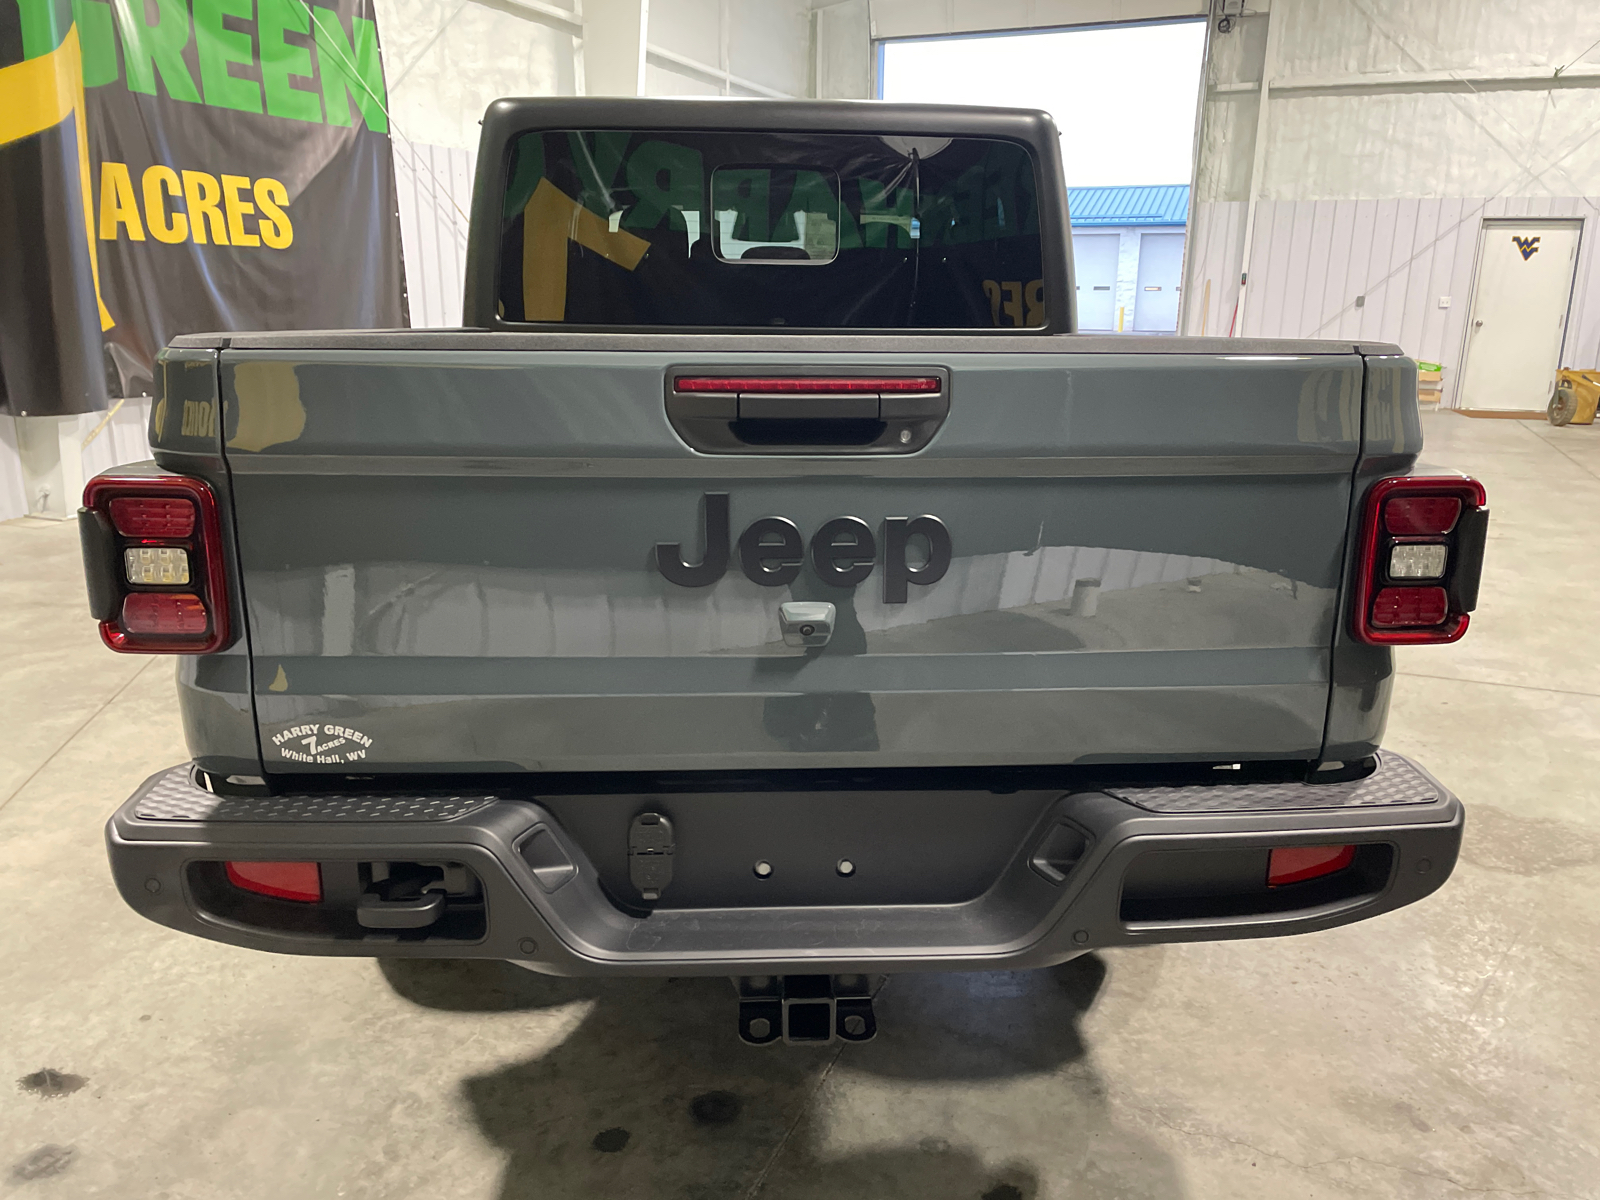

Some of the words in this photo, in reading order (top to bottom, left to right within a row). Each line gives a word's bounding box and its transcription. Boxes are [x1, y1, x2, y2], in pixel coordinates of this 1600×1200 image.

[99, 162, 294, 250] ACRES
[655, 491, 952, 604] Jeep
[271, 724, 319, 746] HARRY
[323, 724, 373, 748] GREEN
[301, 735, 317, 755] 7
[317, 737, 346, 753] ACRES
[281, 747, 314, 763] White
[316, 755, 345, 764] Hall,
[346, 749, 366, 761] WV
